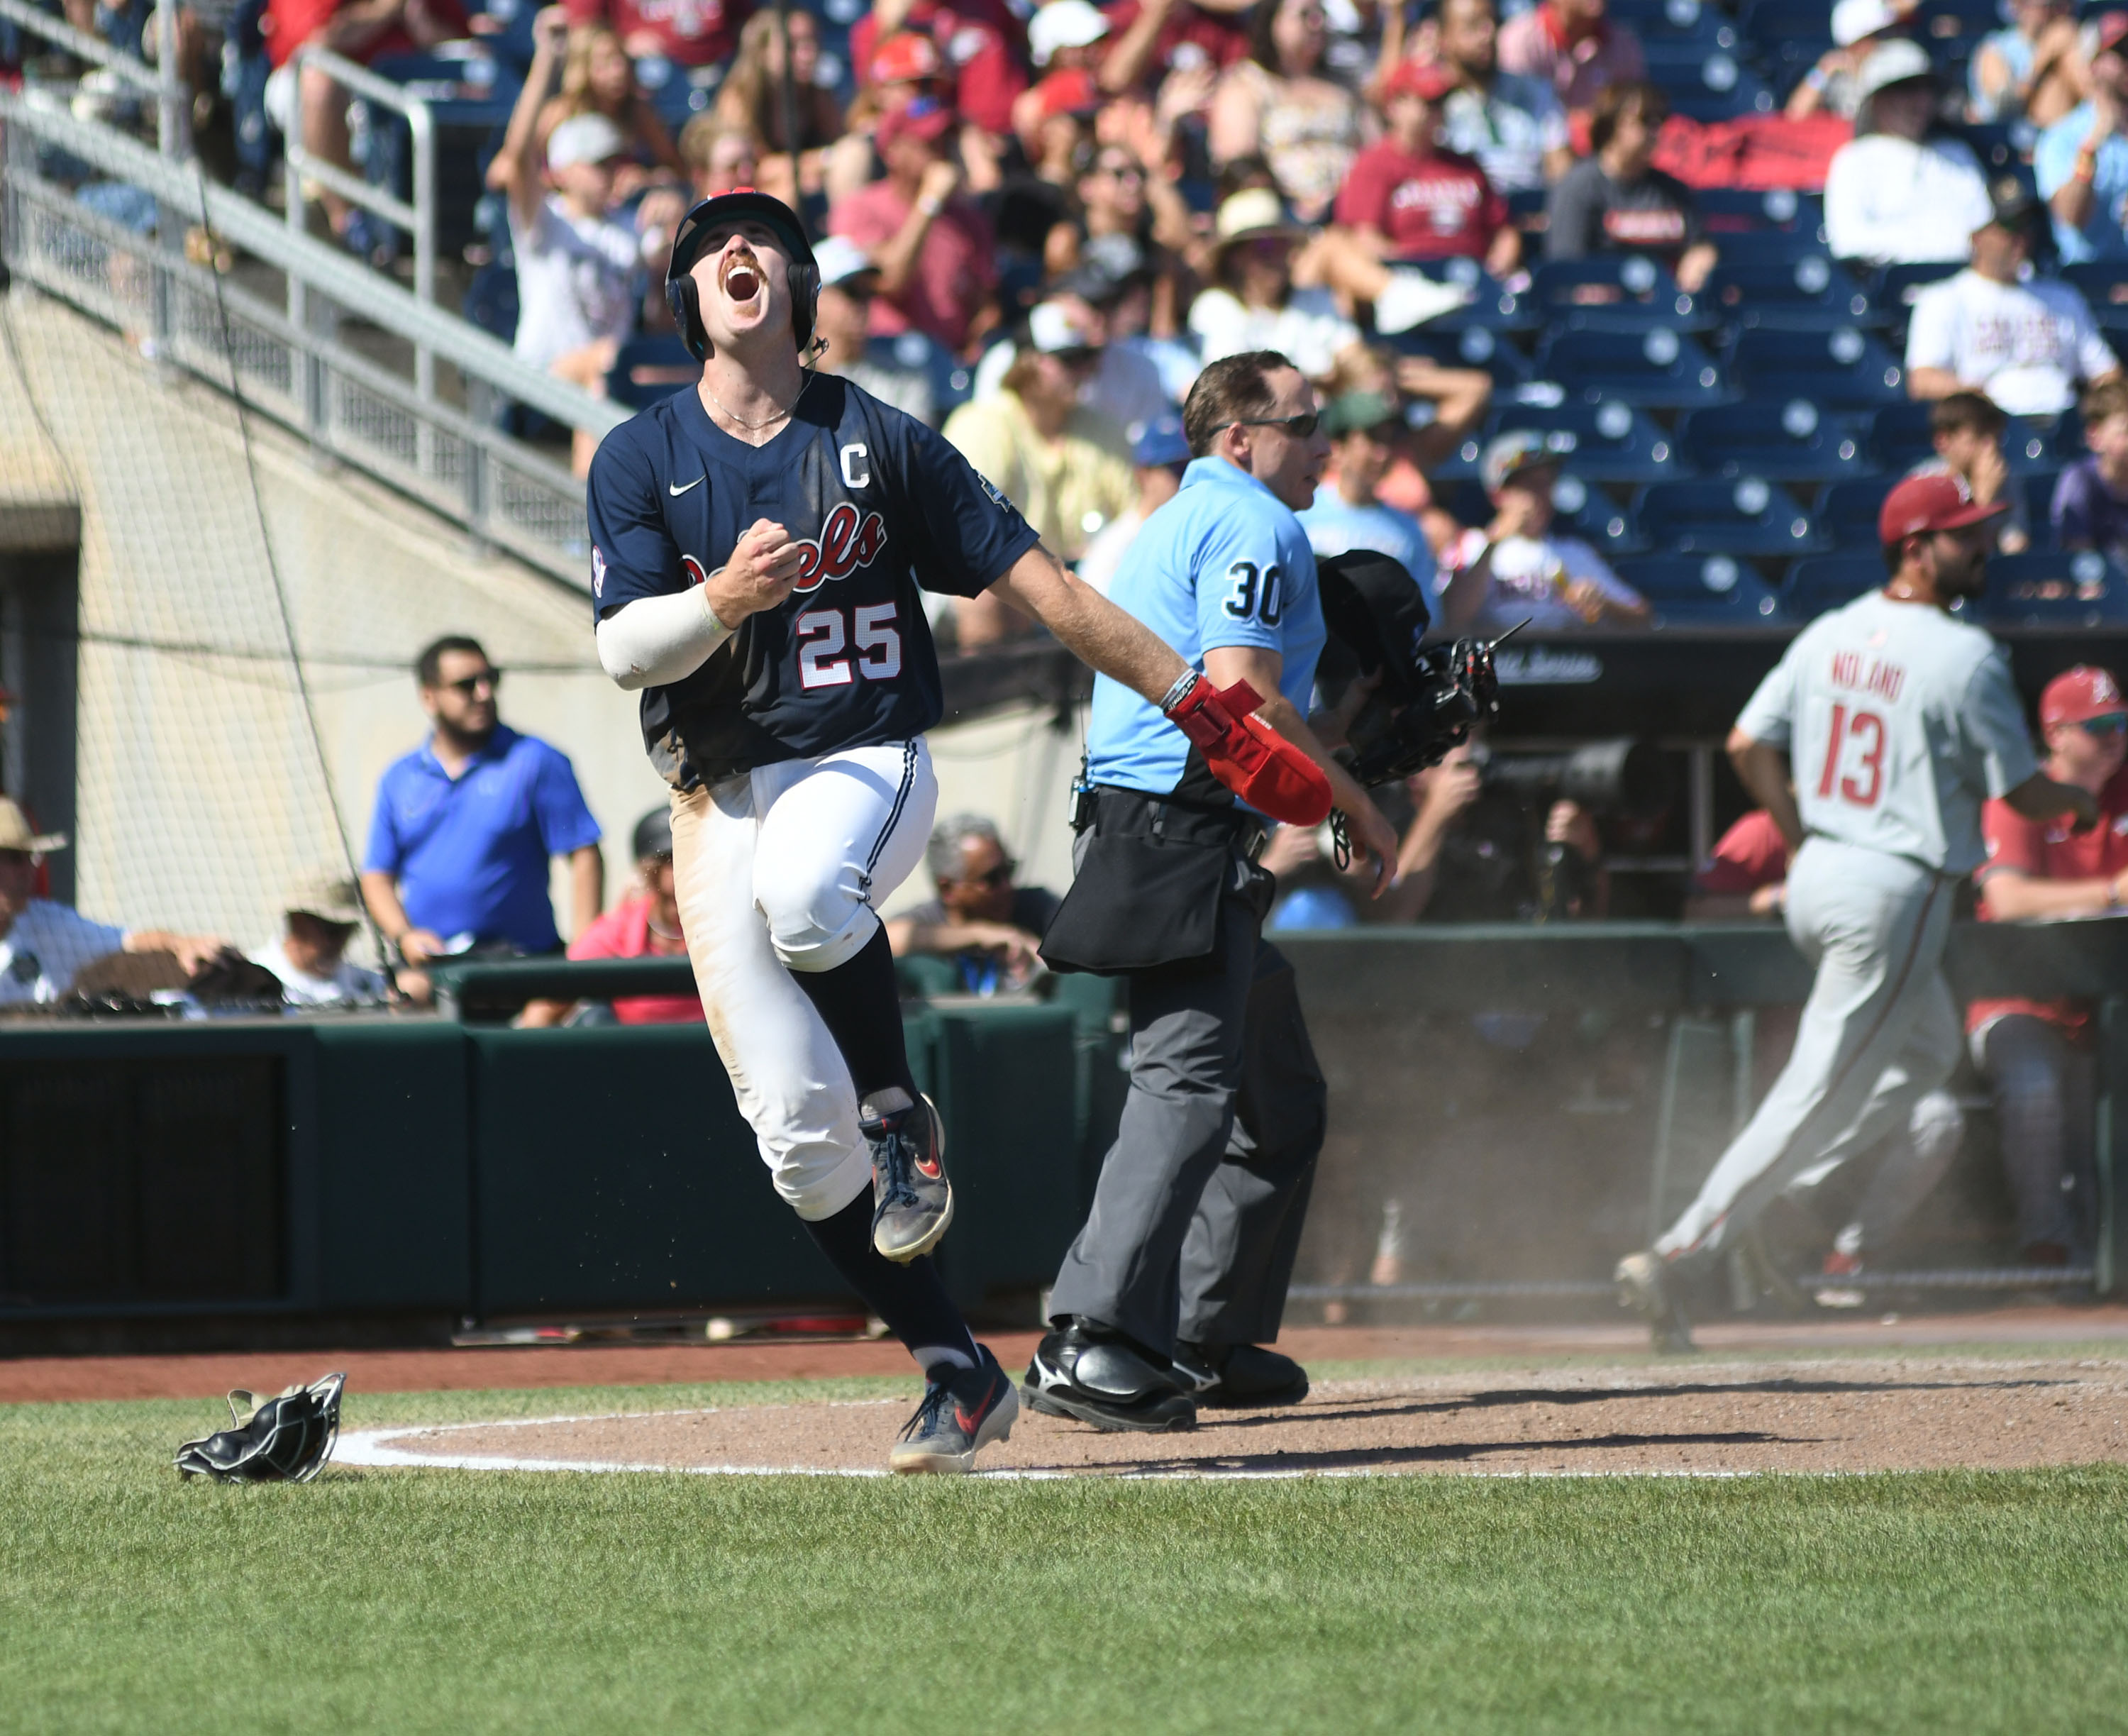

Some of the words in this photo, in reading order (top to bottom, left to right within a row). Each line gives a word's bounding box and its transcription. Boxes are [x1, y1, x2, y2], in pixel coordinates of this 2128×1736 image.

[839, 443, 870, 489] C
[1221, 557, 1282, 630] 30
[796, 602, 902, 690] 25
[1817, 703, 1887, 808] 13
